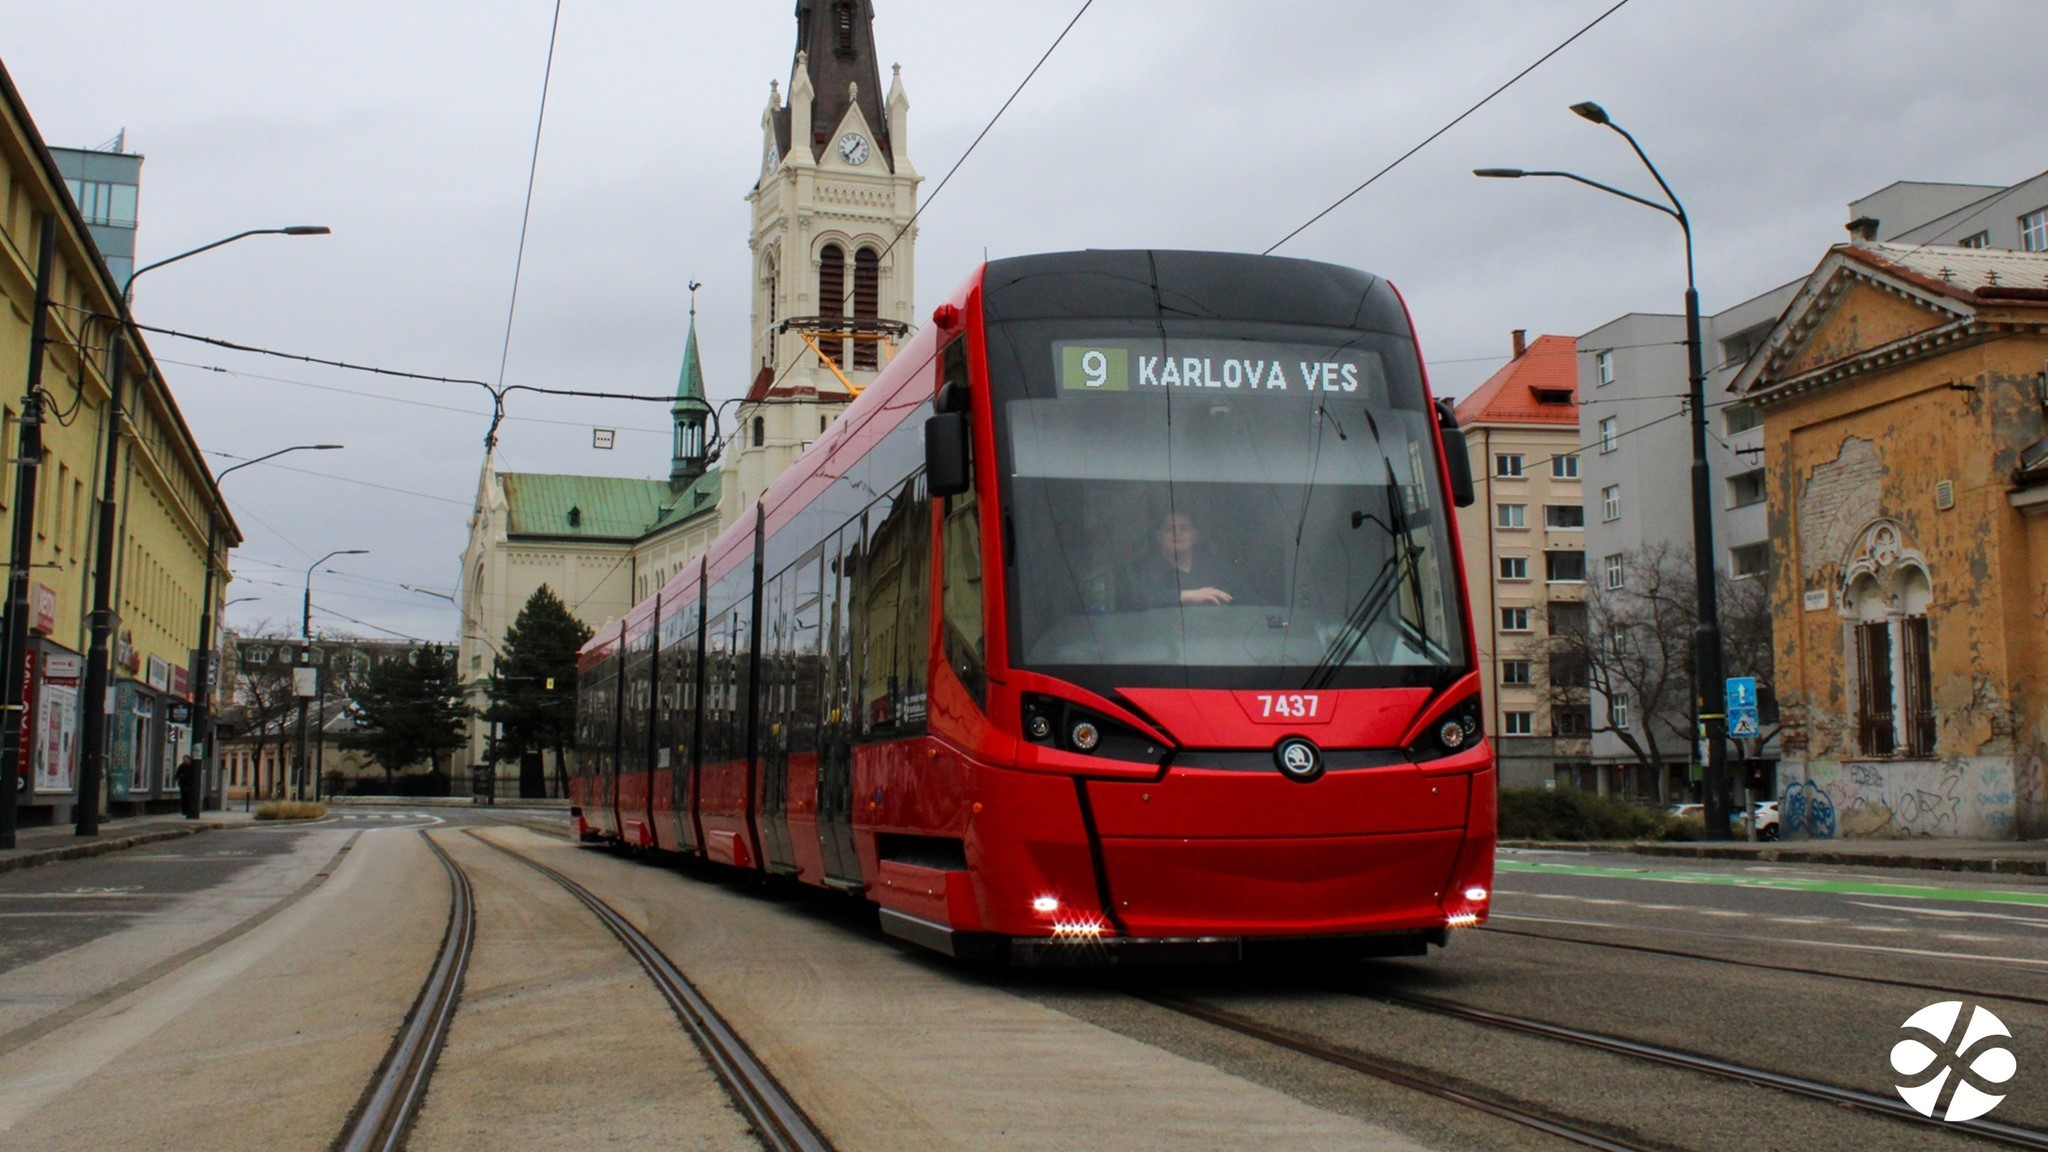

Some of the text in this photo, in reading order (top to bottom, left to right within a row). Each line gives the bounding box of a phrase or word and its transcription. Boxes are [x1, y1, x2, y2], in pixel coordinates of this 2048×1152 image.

[1081, 351, 1107, 387] 9
[1138, 356, 1358, 391] KARLOVA VES
[1257, 694, 1318, 717] 7437
[113, 682, 131, 769] OPTIKA
